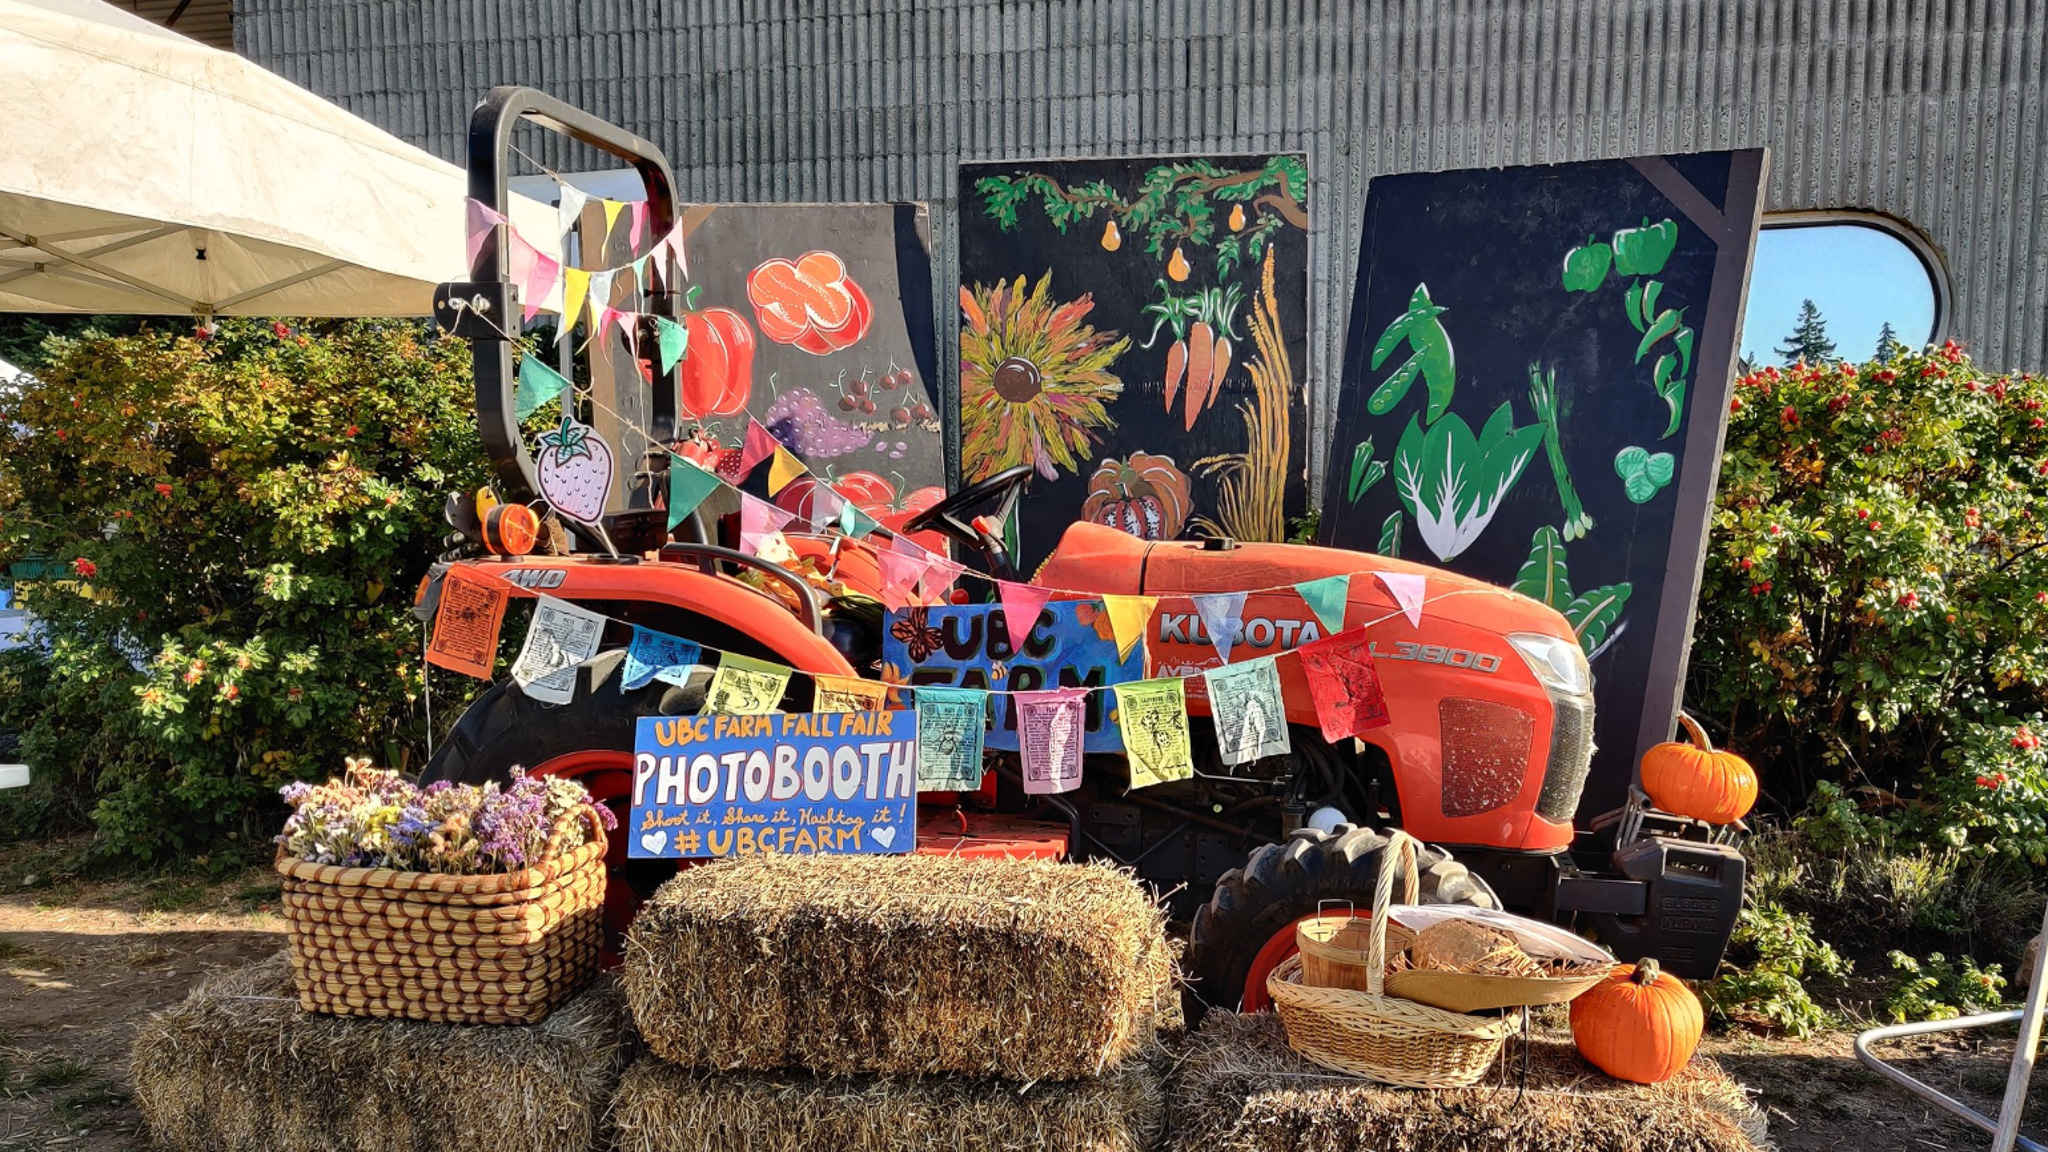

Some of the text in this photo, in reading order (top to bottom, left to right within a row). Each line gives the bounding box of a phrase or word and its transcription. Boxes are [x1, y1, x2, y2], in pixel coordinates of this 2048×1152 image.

[499, 569, 568, 589] 4WD
[942, 609, 1057, 661] UBC
[1369, 640, 1503, 673] L3800
[655, 711, 894, 747] UBC FARM FALL FAIR
[632, 740, 916, 807] PHOTOBOOTH
[641, 809, 690, 831] Shoot
[721, 806, 768, 825] Share
[798, 806, 867, 830] Hashtag
